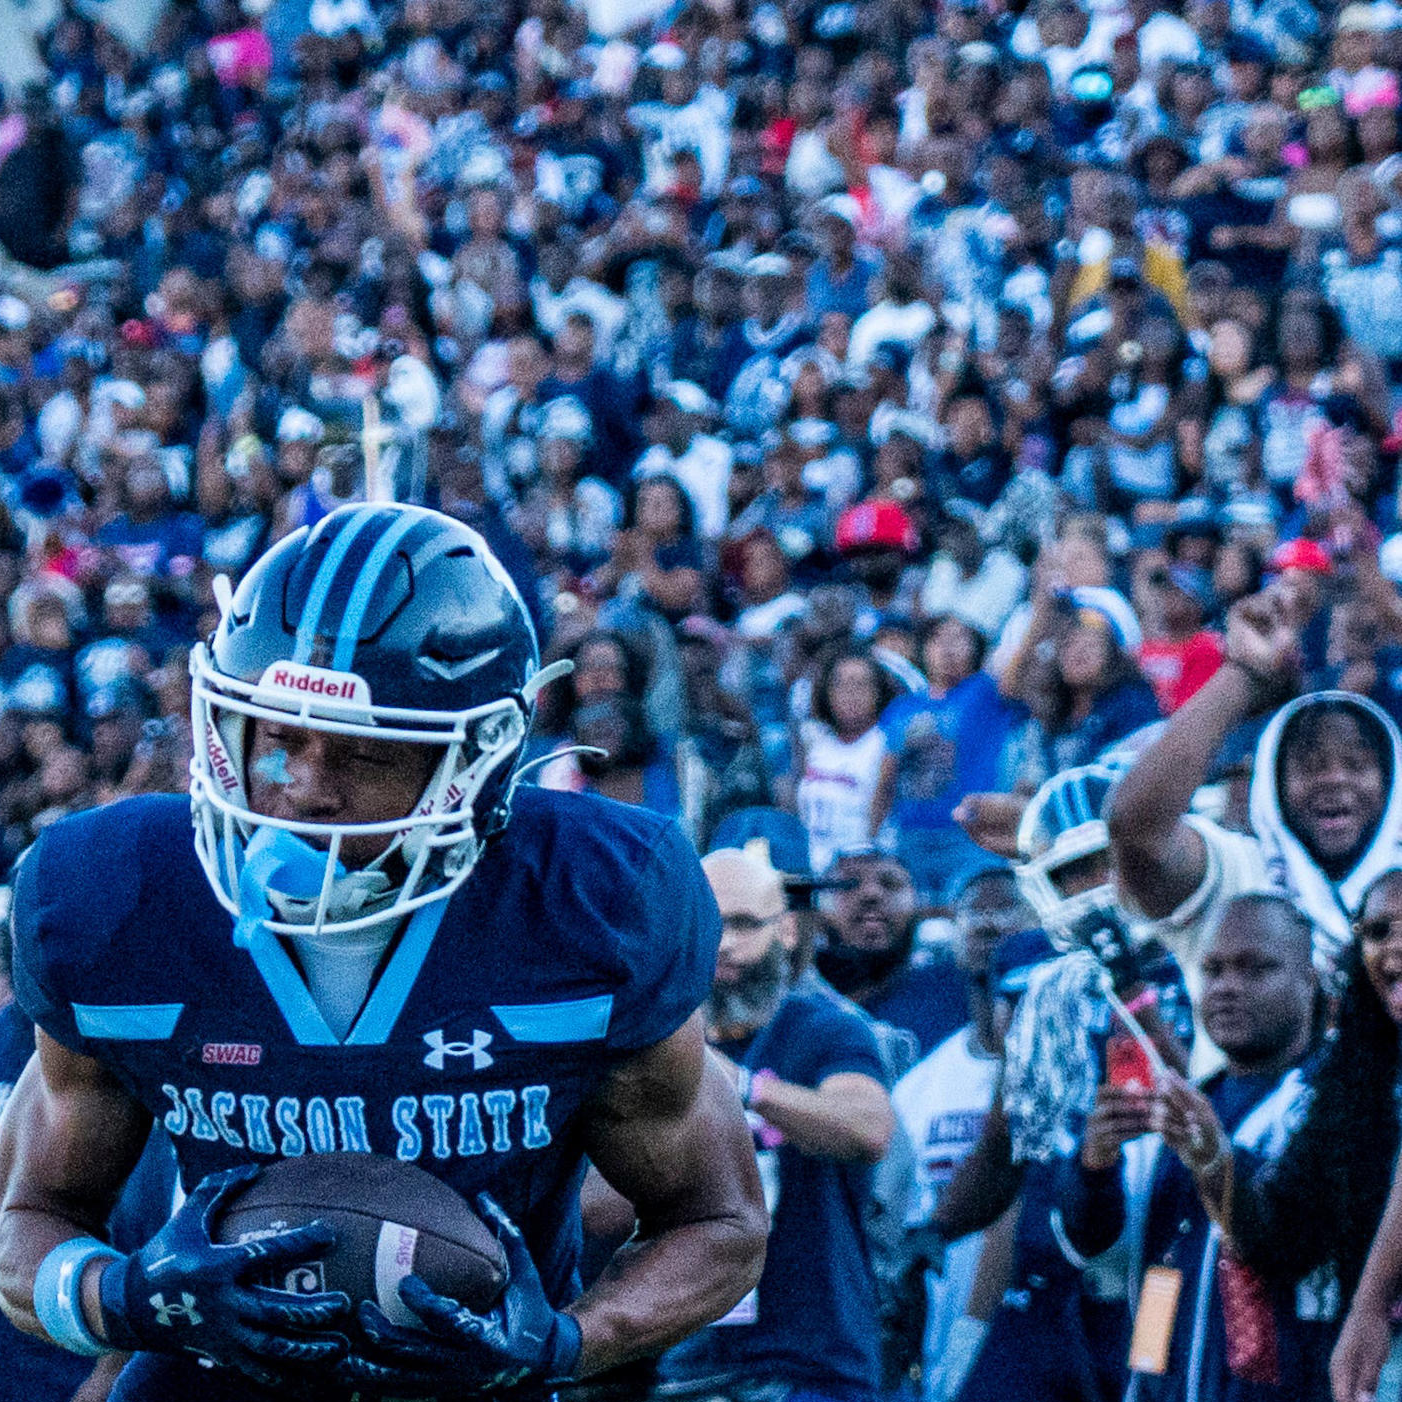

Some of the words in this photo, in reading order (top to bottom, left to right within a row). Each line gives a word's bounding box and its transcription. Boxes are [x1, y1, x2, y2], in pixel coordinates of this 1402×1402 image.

[273, 669, 357, 700] Riddell
[201, 1042, 263, 1066] SWAC
[161, 1083, 373, 1158] JACKSON
[391, 1084, 553, 1162] STATE
